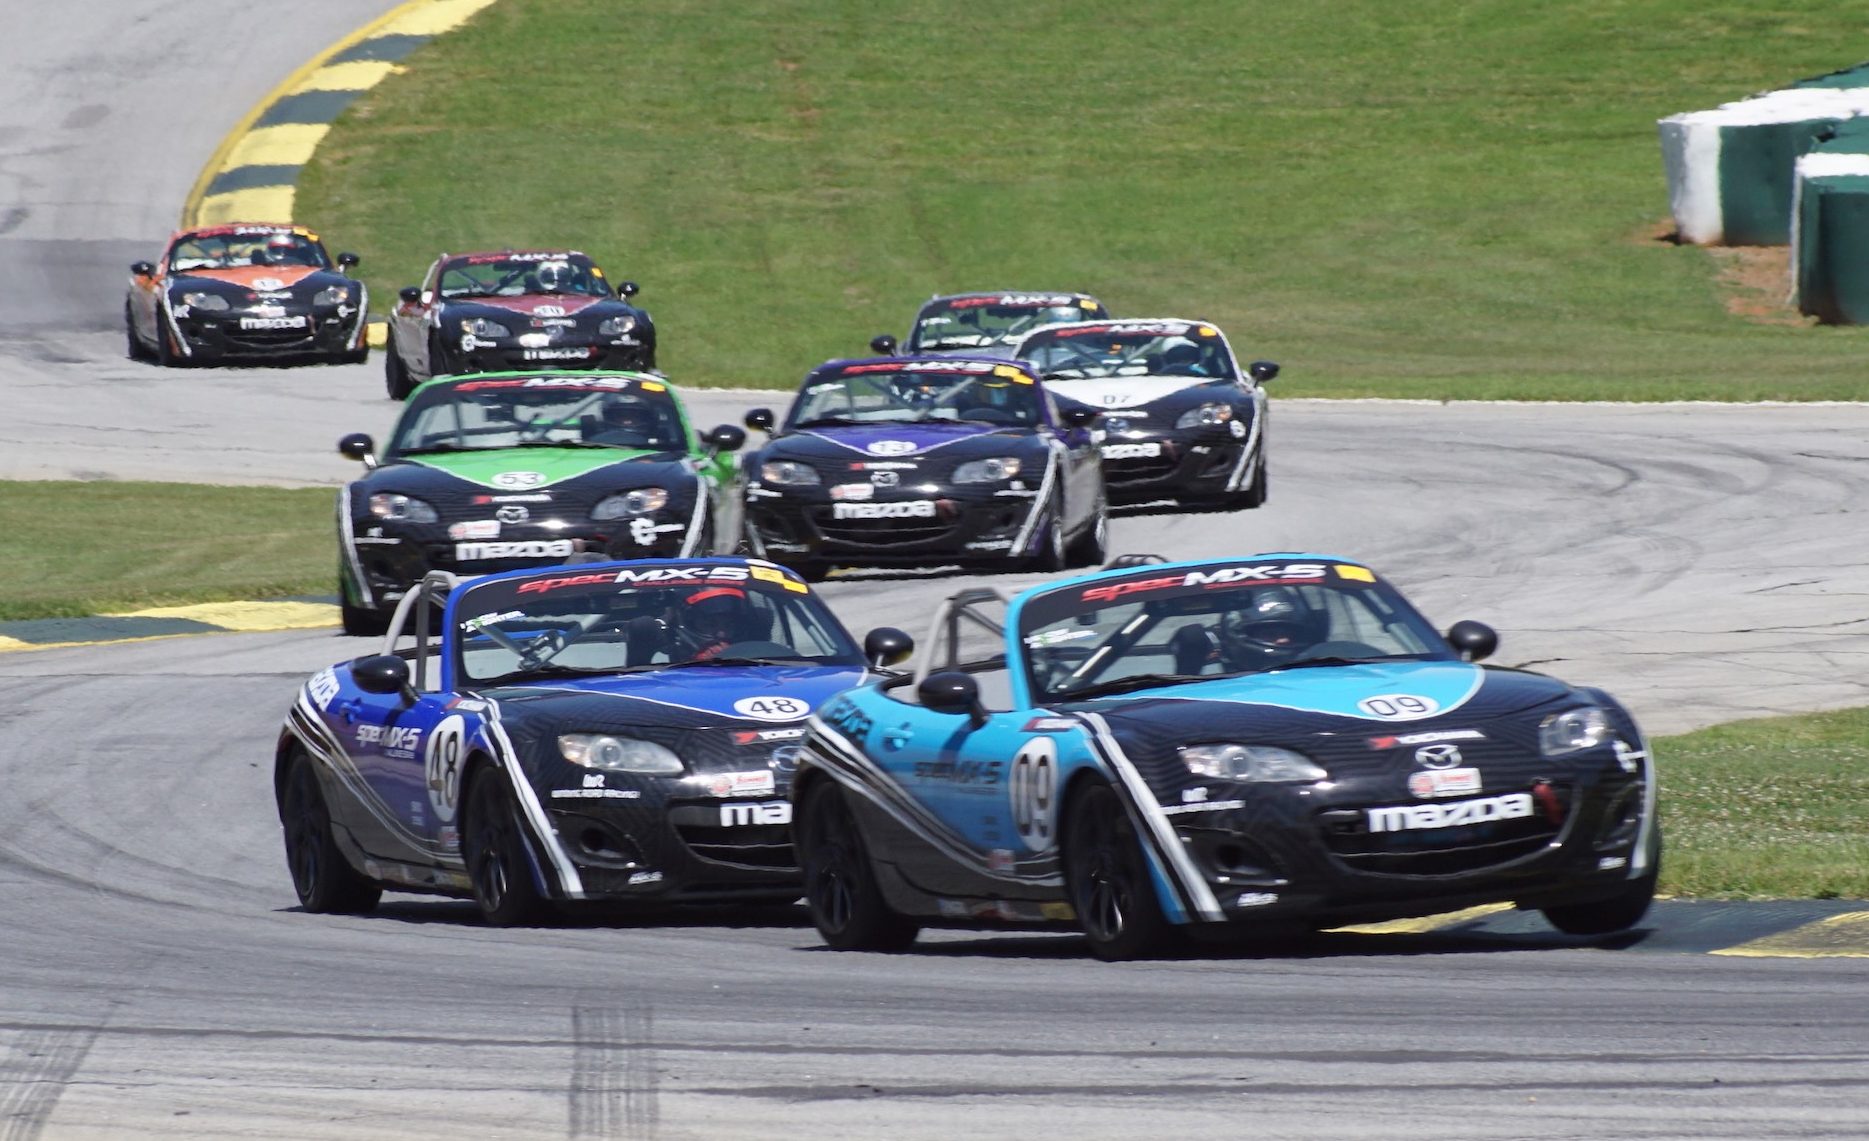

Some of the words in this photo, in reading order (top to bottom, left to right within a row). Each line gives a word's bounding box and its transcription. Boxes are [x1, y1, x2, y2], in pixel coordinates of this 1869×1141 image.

[1101, 442, 1161, 459] azda
[501, 473, 539, 485] 53
[833, 500, 937, 520] mazda
[455, 539, 574, 561] mazda
[516, 572, 618, 594] spec
[613, 566, 750, 584] MX-5
[1081, 575, 1186, 602] spec
[1182, 563, 1327, 586] MX-5
[750, 699, 799, 714] 48
[1366, 696, 1428, 717] 09
[381, 725, 423, 751] MX-5
[429, 731, 458, 808] 48
[1015, 753, 1050, 838] 09
[1368, 793, 1535, 833] mazda
